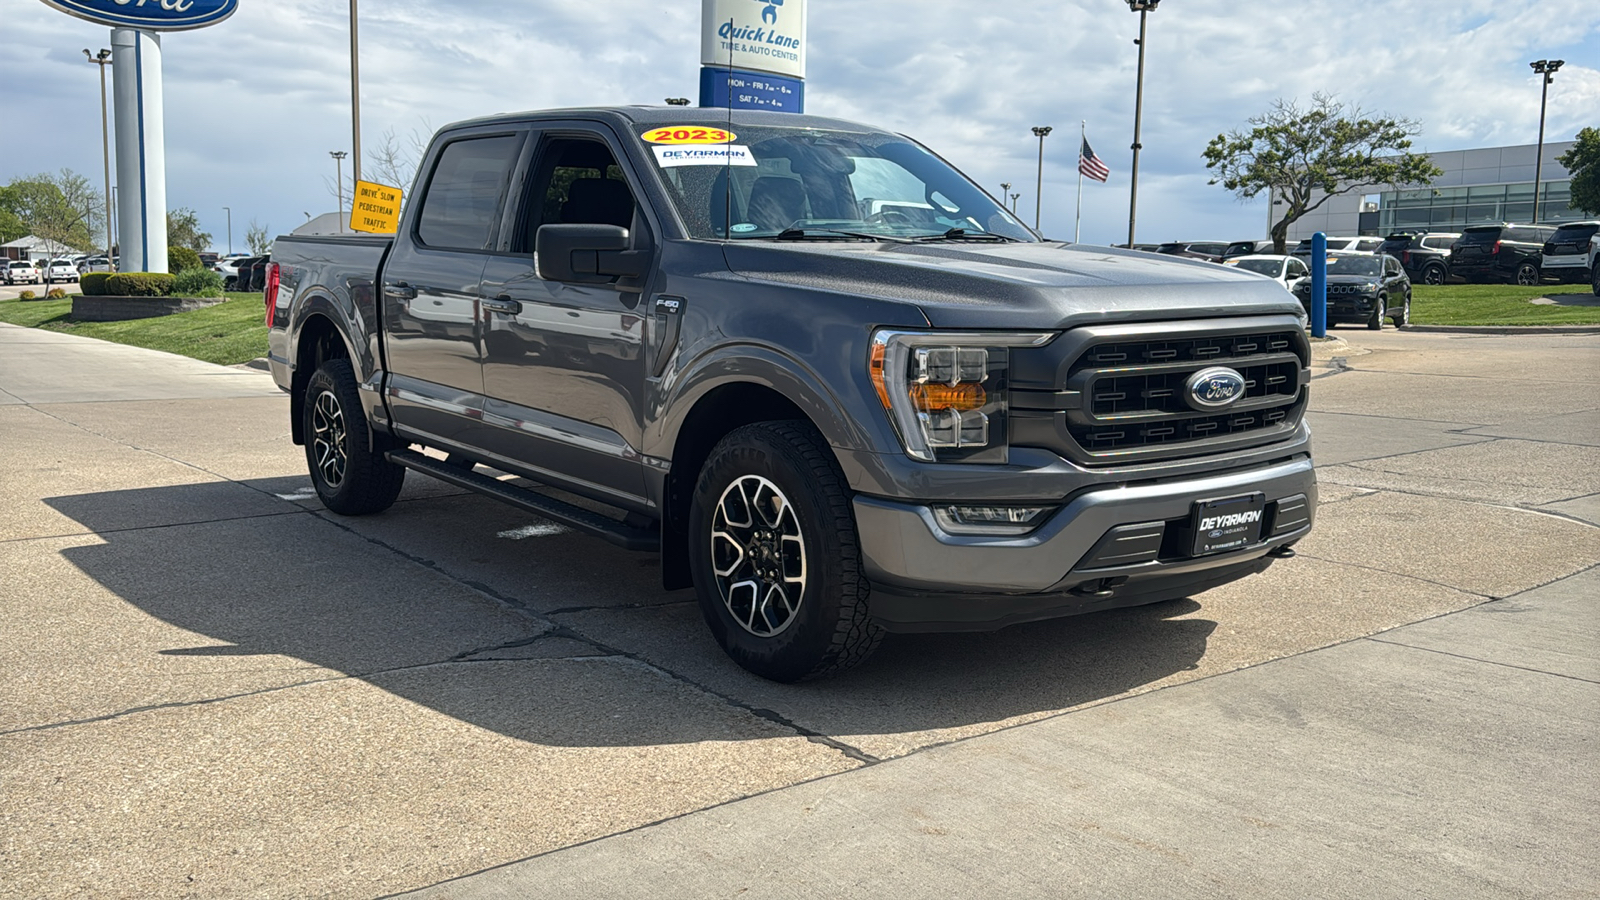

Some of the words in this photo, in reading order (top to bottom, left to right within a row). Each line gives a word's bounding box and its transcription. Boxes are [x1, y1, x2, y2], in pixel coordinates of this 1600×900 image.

[718, 22, 765, 41] Quick
[766, 30, 800, 49] Lane
[721, 41, 739, 51] TIRE
[741, 44, 746, 52] &
[749, 45, 770, 55] AUTO
[772, 49, 798, 61] CENTER
[728, 79, 744, 87] MON
[739, 94, 752, 103] SAT
[654, 130, 727, 141] 2023
[662, 150, 746, 158] DEYARMAN
[360, 187, 378, 199] DRIVE
[380, 191, 396, 202] SLOW
[358, 201, 394, 217] PEDESTRIAN
[363, 217, 387, 229] TRAFFIC
[1206, 379, 1236, 399] Ford
[1199, 509, 1262, 532] DEYARMAN
[1223, 525, 1248, 535] INDIANOLA
